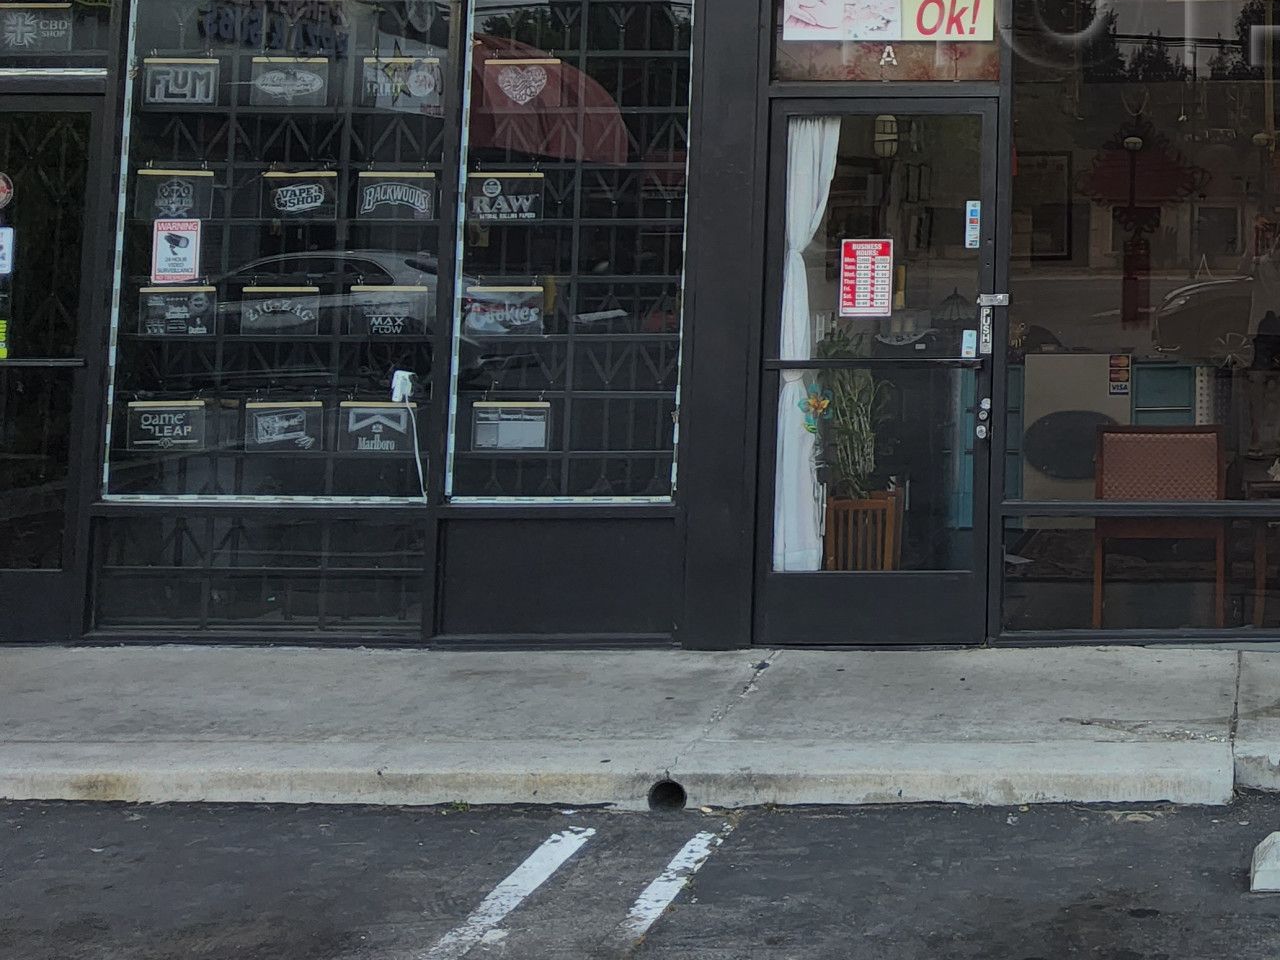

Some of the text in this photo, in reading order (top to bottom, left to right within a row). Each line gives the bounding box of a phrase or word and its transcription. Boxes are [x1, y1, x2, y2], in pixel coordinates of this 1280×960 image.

[40, 20, 68, 30] CBD
[41, 30, 66, 38] SHOP
[879, 45, 898, 66] A
[147, 67, 214, 104] FLUM
[280, 187, 315, 199] VAPE
[363, 183, 430, 211] BACKWOODS
[287, 194, 322, 209] SHOP
[471, 194, 536, 213] RAW
[158, 222, 198, 231] WARNING
[245, 299, 315, 321] ZIG-ZAG
[370, 317, 404, 326] MAX
[982, 308, 991, 343] PUSH
[372, 326, 403, 334] FLOW
[1111, 383, 1128, 391] VISA
[141, 413, 186, 433] game
[155, 425, 192, 436] LEAF
[358, 434, 395, 450] Marlboro
